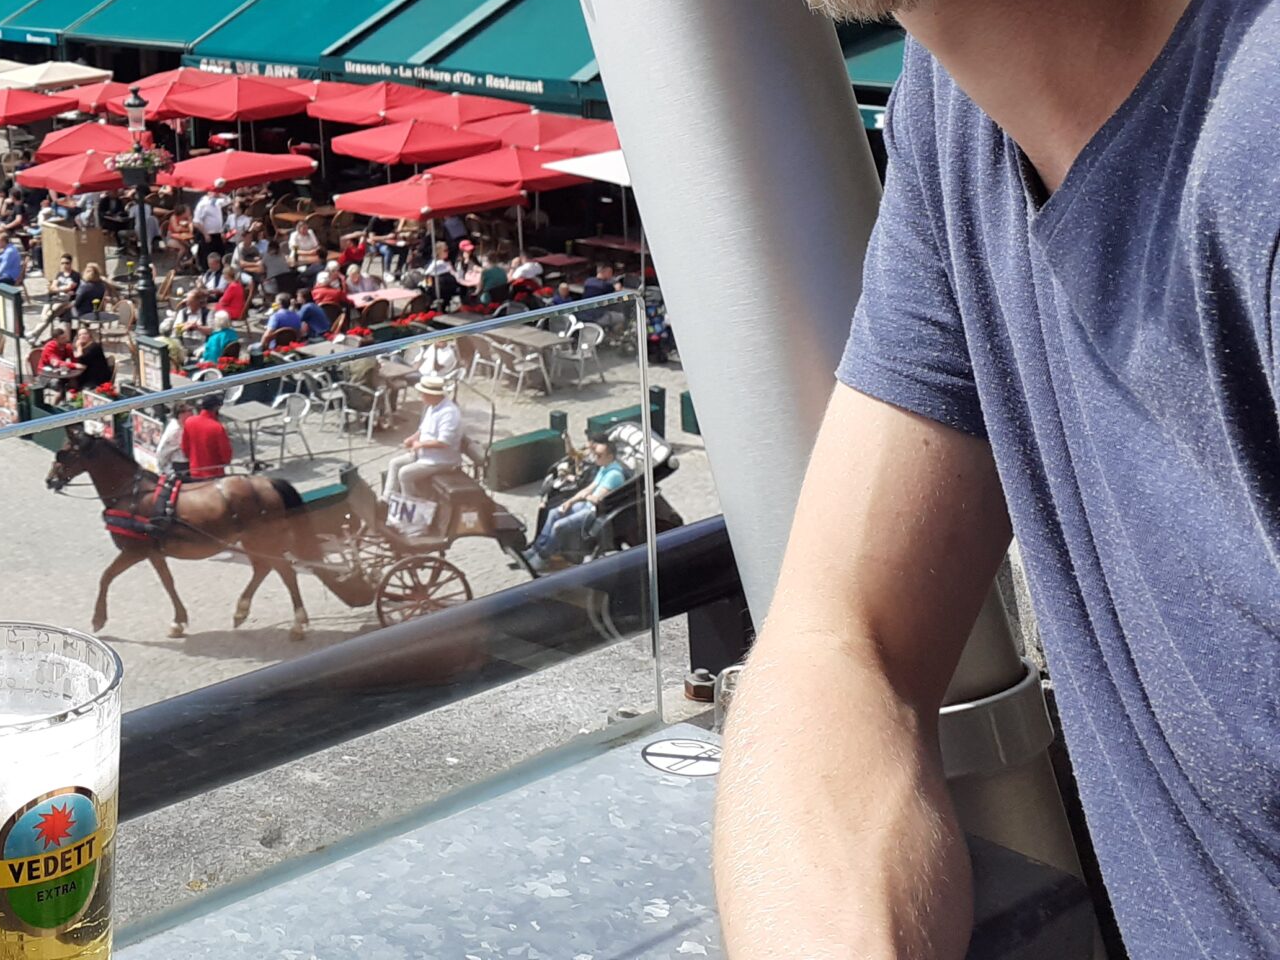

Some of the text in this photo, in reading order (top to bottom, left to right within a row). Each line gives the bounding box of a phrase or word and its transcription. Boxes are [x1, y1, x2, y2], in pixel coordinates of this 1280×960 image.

[265, 63, 299, 79] ARTS
[345, 61, 391, 76] Brasserie
[399, 66, 413, 78] La
[453, 71, 476, 86] d'Or
[486, 74, 544, 93] Restaurant
[8, 836, 96, 884] VEDETT
[36, 880, 77, 903] EXTRA
